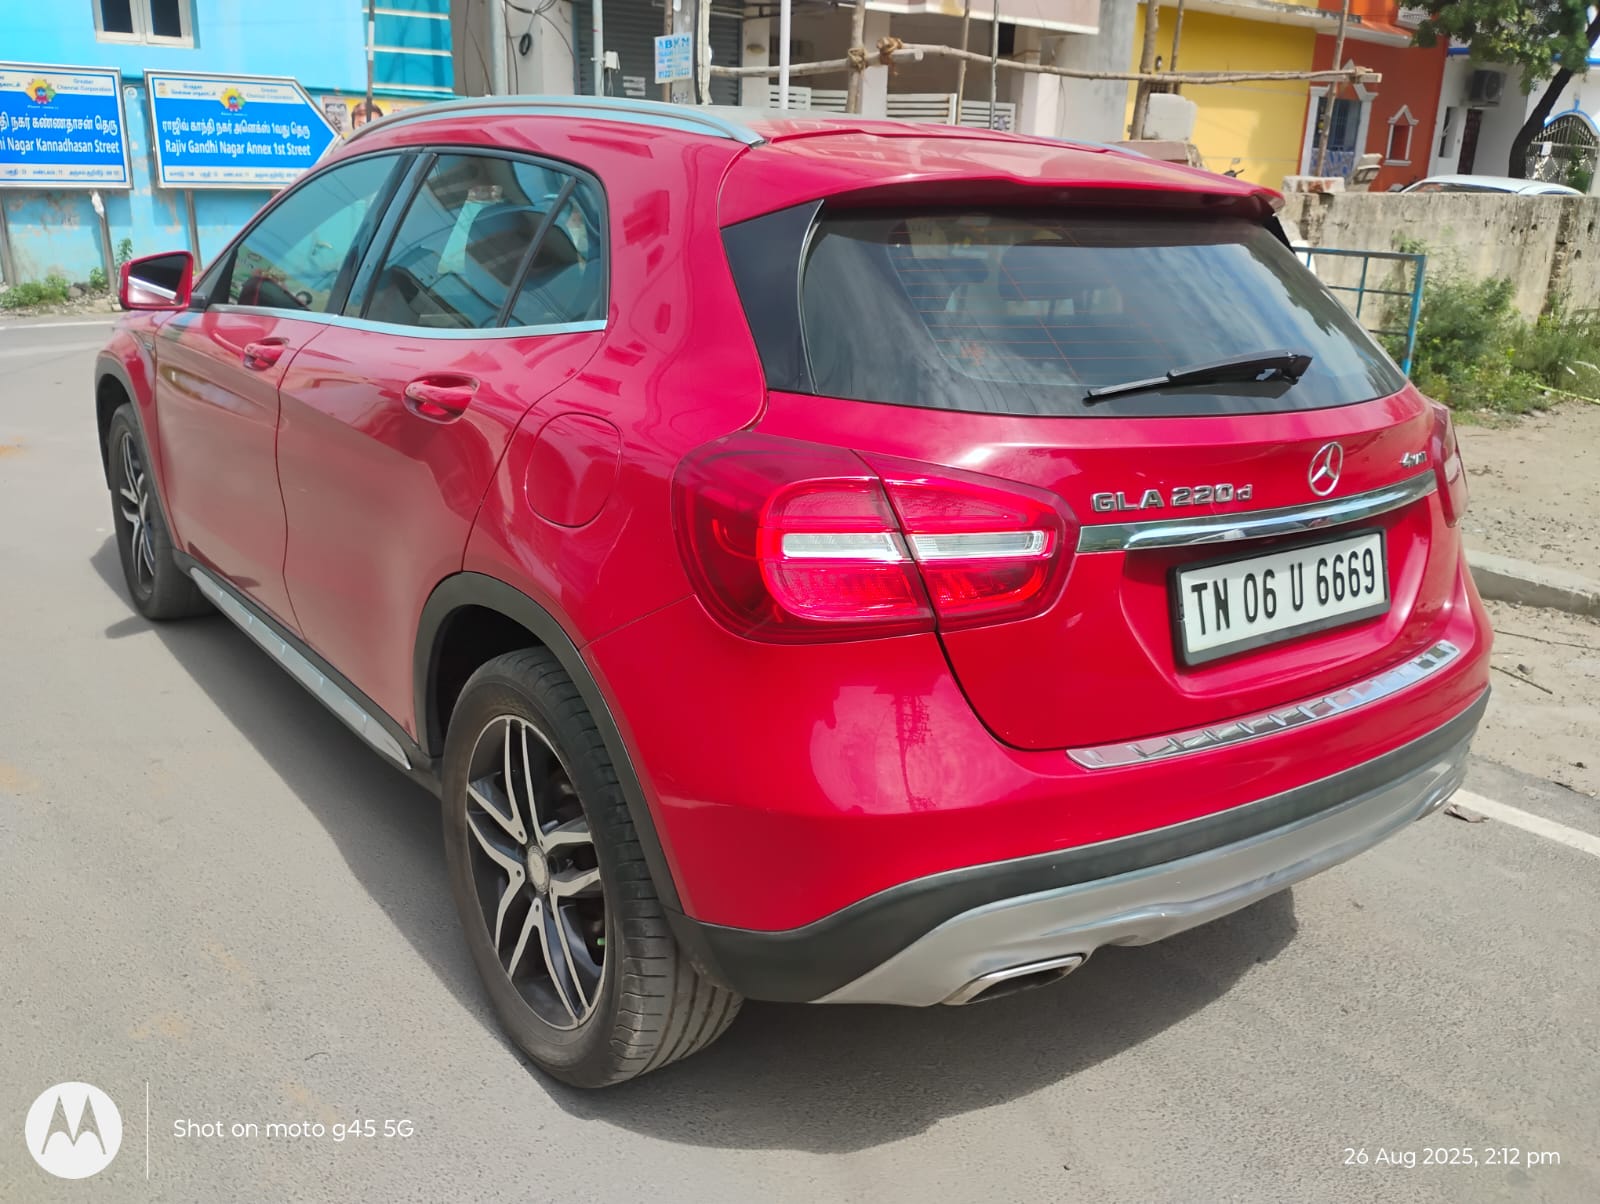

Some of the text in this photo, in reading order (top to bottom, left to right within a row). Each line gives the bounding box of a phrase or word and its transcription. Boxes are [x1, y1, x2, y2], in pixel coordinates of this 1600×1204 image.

[11, 113, 31, 132] நகர்
[32, 113, 94, 133] கண்ணதாசன்
[95, 114, 118, 136] தெரு
[190, 118, 215, 136] காந்தி
[216, 119, 232, 136] நகர்
[290, 121, 311, 139] தெரு
[7, 137, 34, 155] Nagar
[36, 138, 93, 153] Kannadhasan
[94, 139, 120, 153] Street
[165, 139, 311, 158] Rajiv Gandhi Nagar Annex 1st Street
[1091, 489, 1165, 513] GLA
[1190, 547, 1375, 636] TN 06 U 6669
